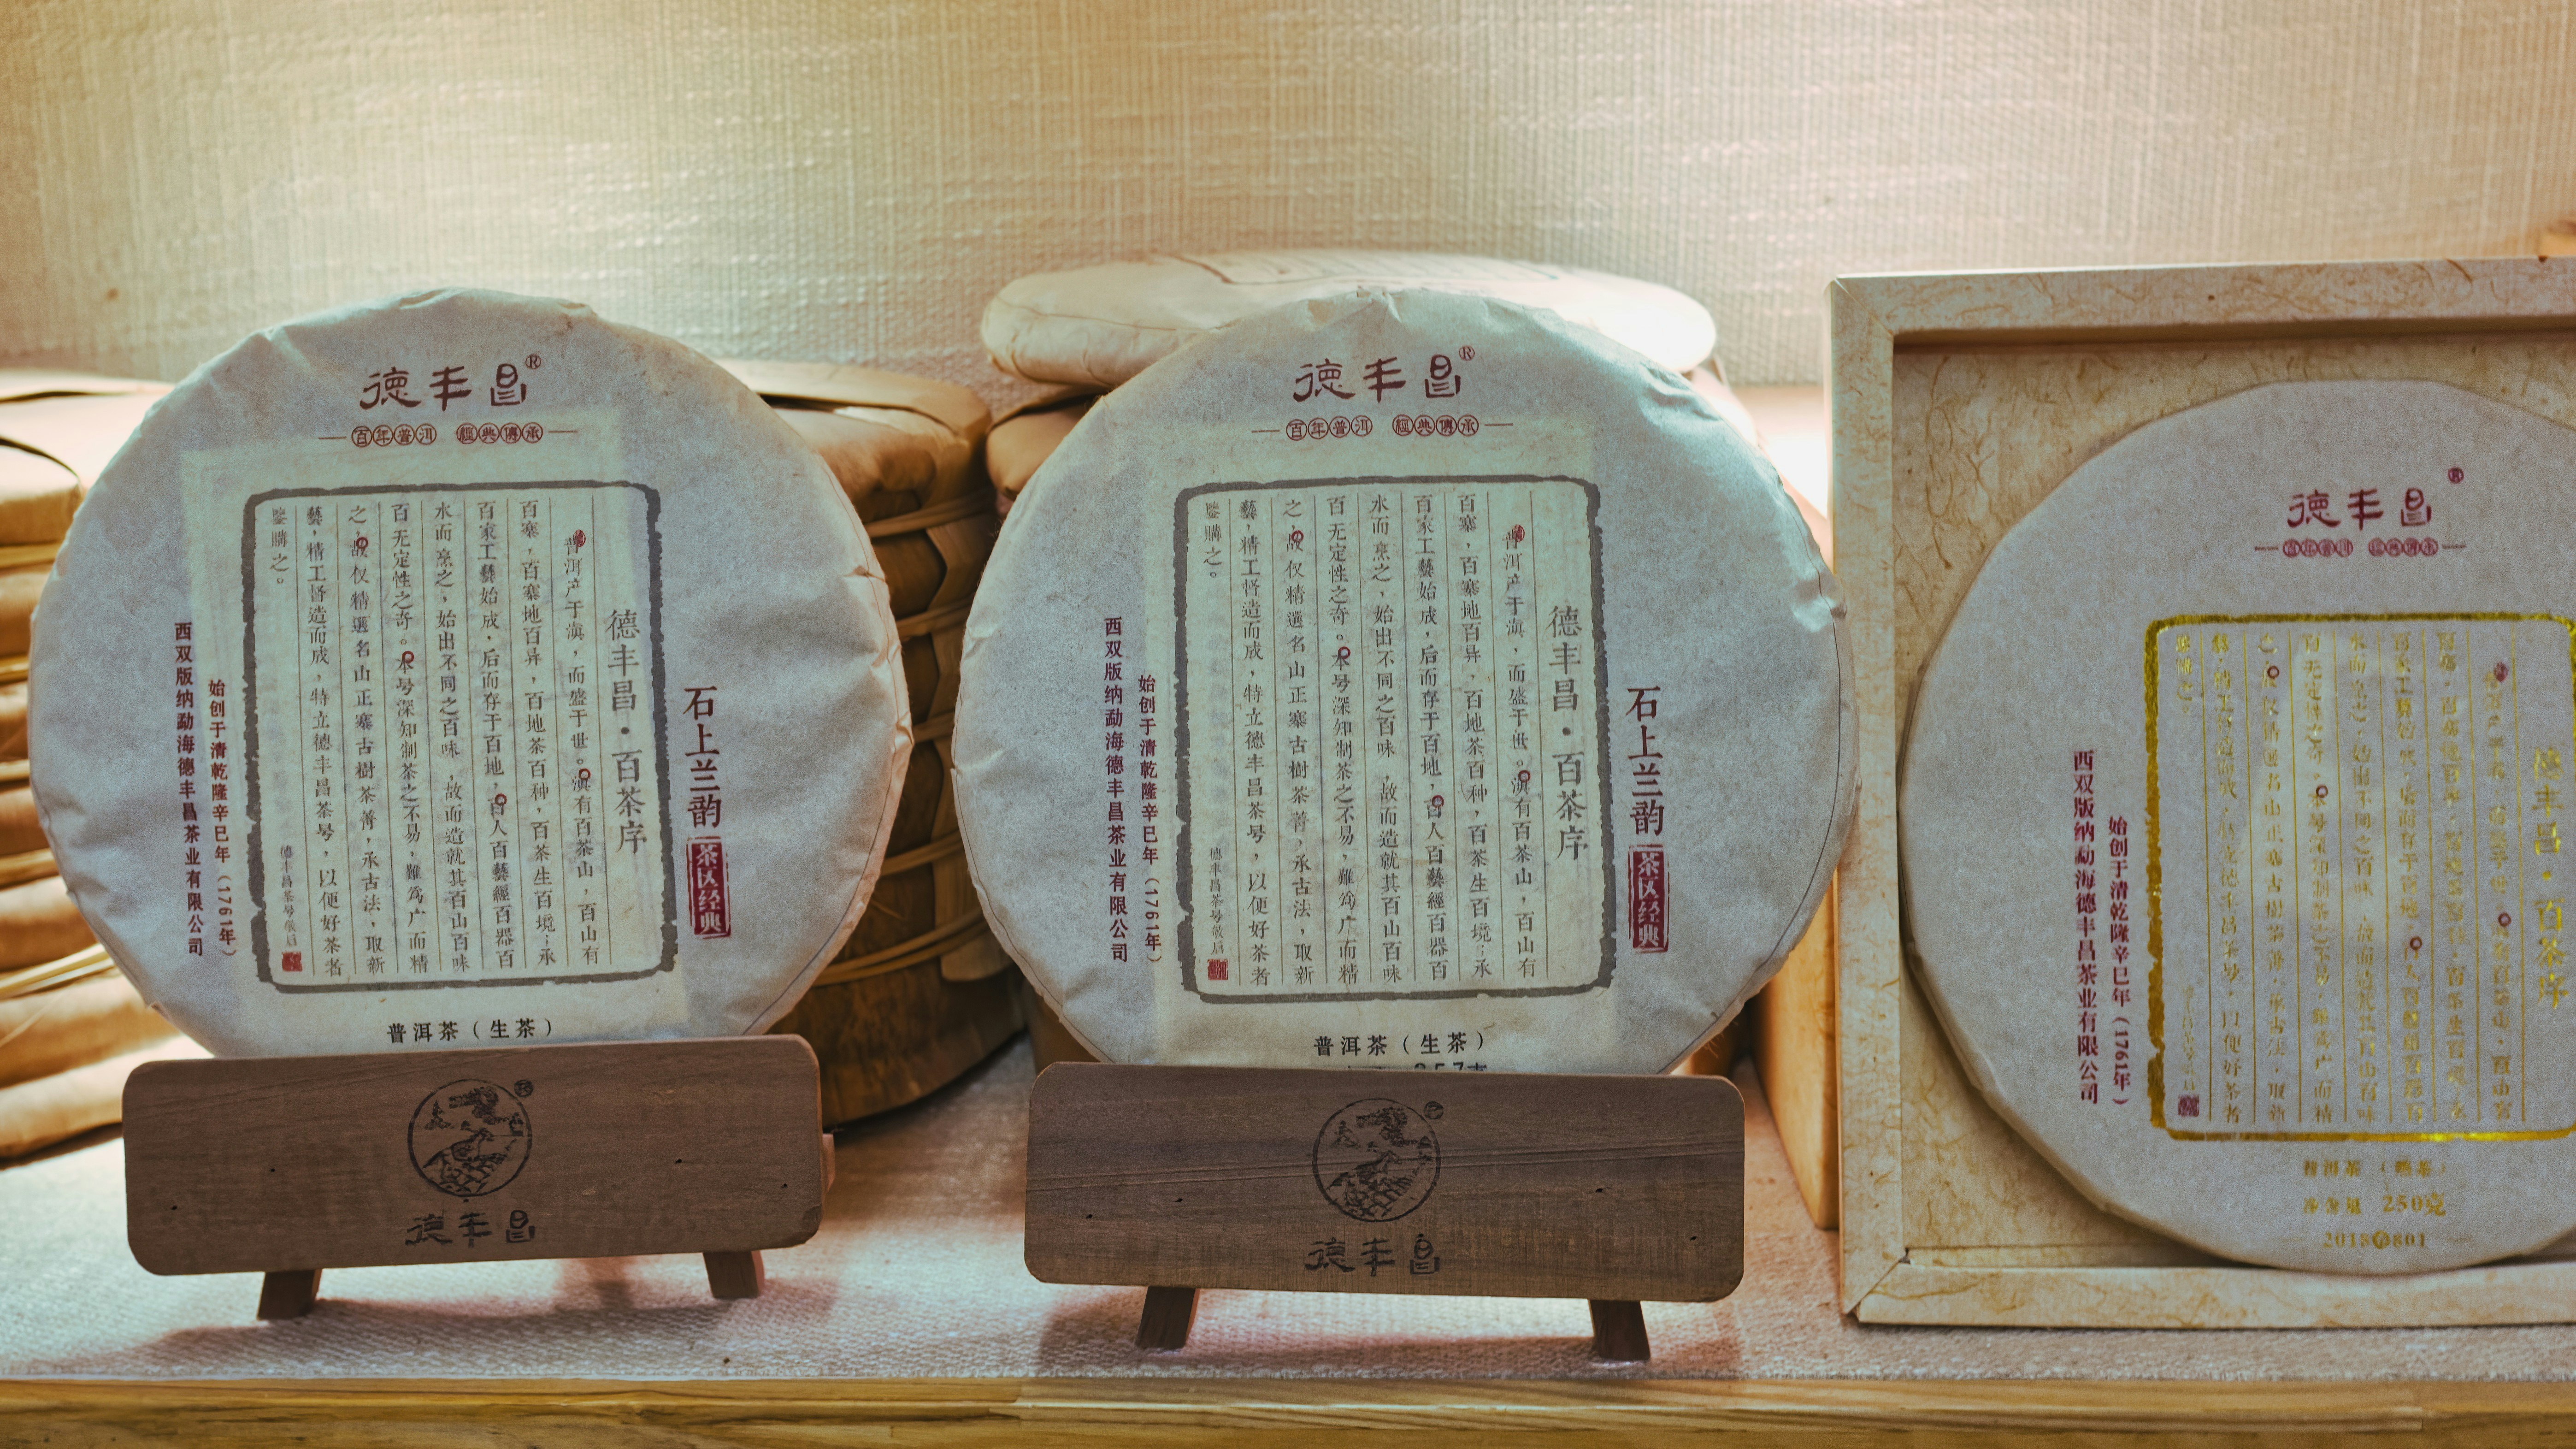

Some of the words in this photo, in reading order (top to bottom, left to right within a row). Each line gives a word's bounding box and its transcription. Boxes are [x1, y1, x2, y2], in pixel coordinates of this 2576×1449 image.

[360, 363, 527, 412] 德丰昌
[1293, 354, 1461, 403] 德丰昌
[351, 424, 437, 447] 百年普洱
[1286, 414, 1373, 441] 百年普洱
[2287, 487, 2432, 531] 德丰昌
[683, 685, 722, 829] 石上兰韵
[1625, 685, 1665, 836] 石上兰韵
[174, 621, 204, 956] 西双版纳勐海德丰昌茶业有限公司
[1103, 616, 1128, 962] 西双版纳勐海德丰昌茶业有限公司
[692, 840, 725, 935] 茶区经典
[1633, 849, 1665, 950] 茶区经典
[2073, 750, 2099, 1105] 西双版纳勐海德丰昌茶业有限公司
[405, 1209, 535, 1248] 德丰昌
[2383, 1192, 2446, 1217] 250克
[1304, 1234, 1440, 1277] 德丰昌
